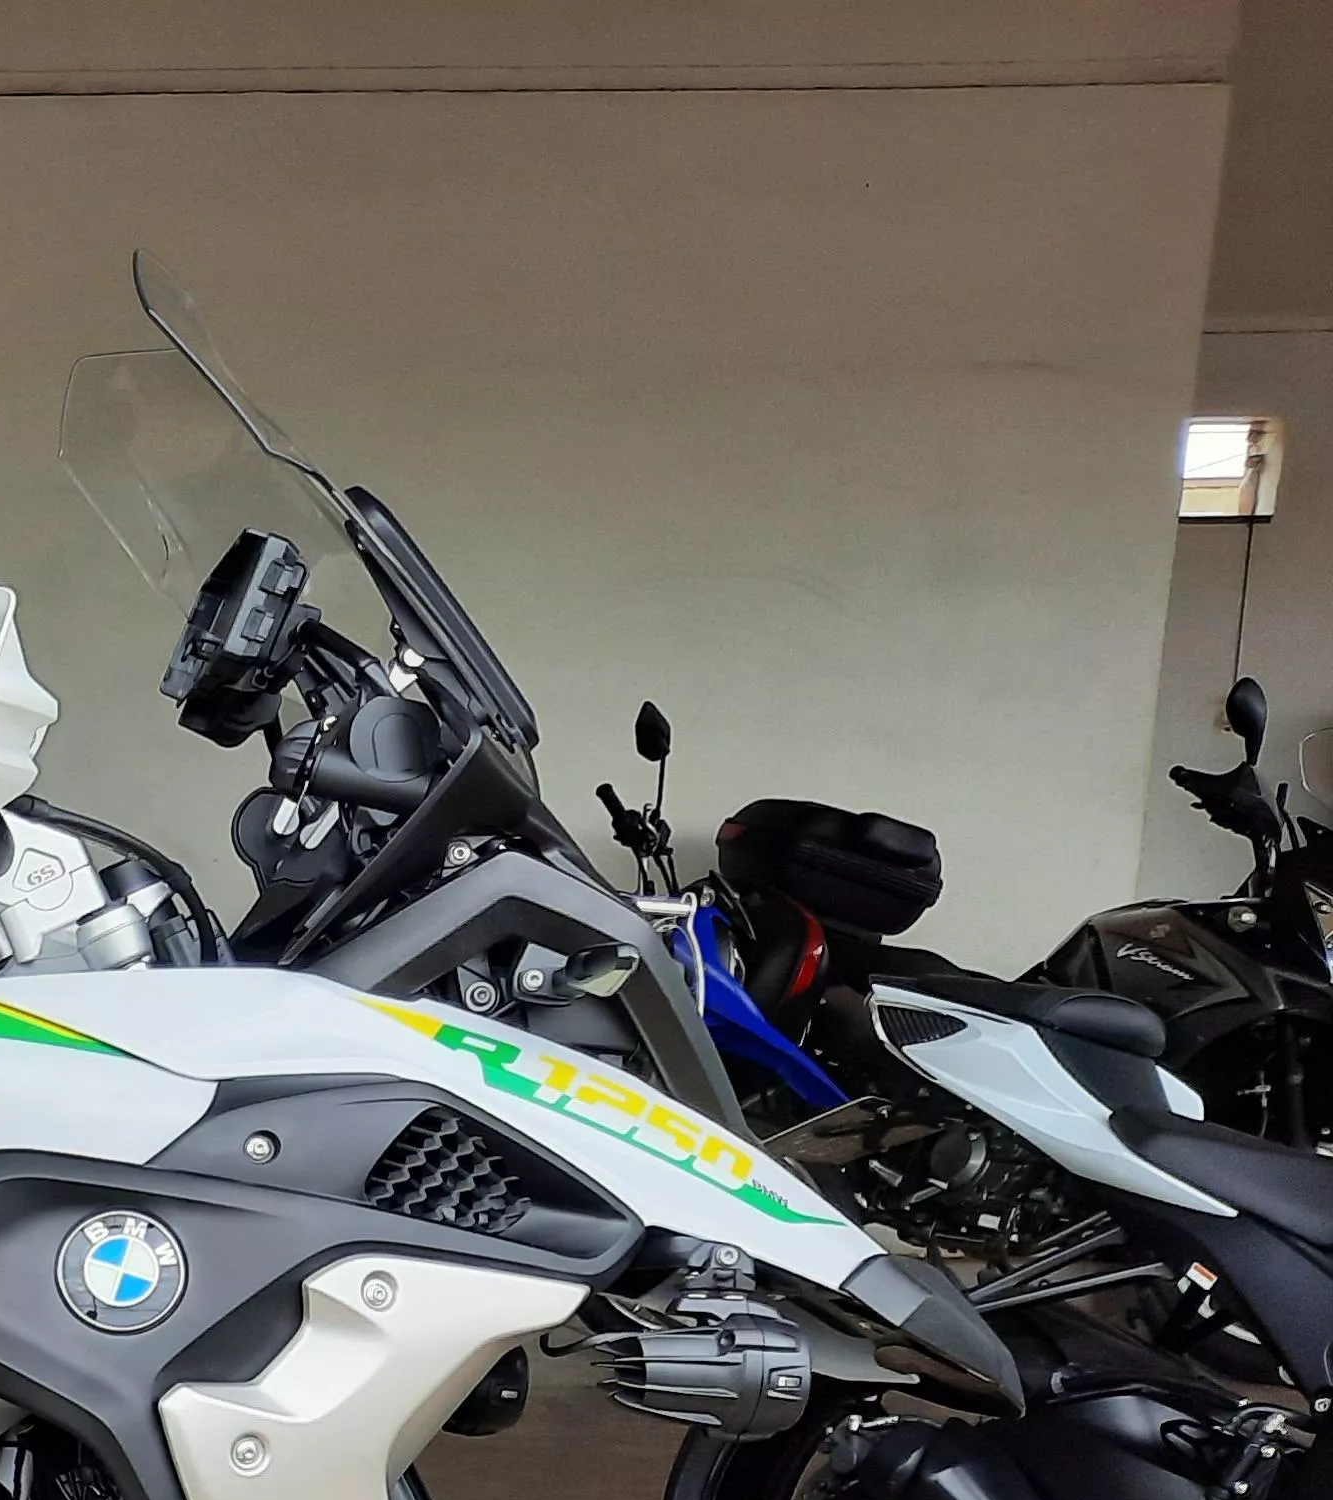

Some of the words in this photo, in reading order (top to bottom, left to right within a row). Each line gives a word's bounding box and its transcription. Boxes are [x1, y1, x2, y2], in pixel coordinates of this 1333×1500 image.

[26, 864, 55, 886] GS
[433, 1024, 541, 1102] R
[538, 1052, 755, 1188] 1250
[81, 1216, 178, 1268] BMW
